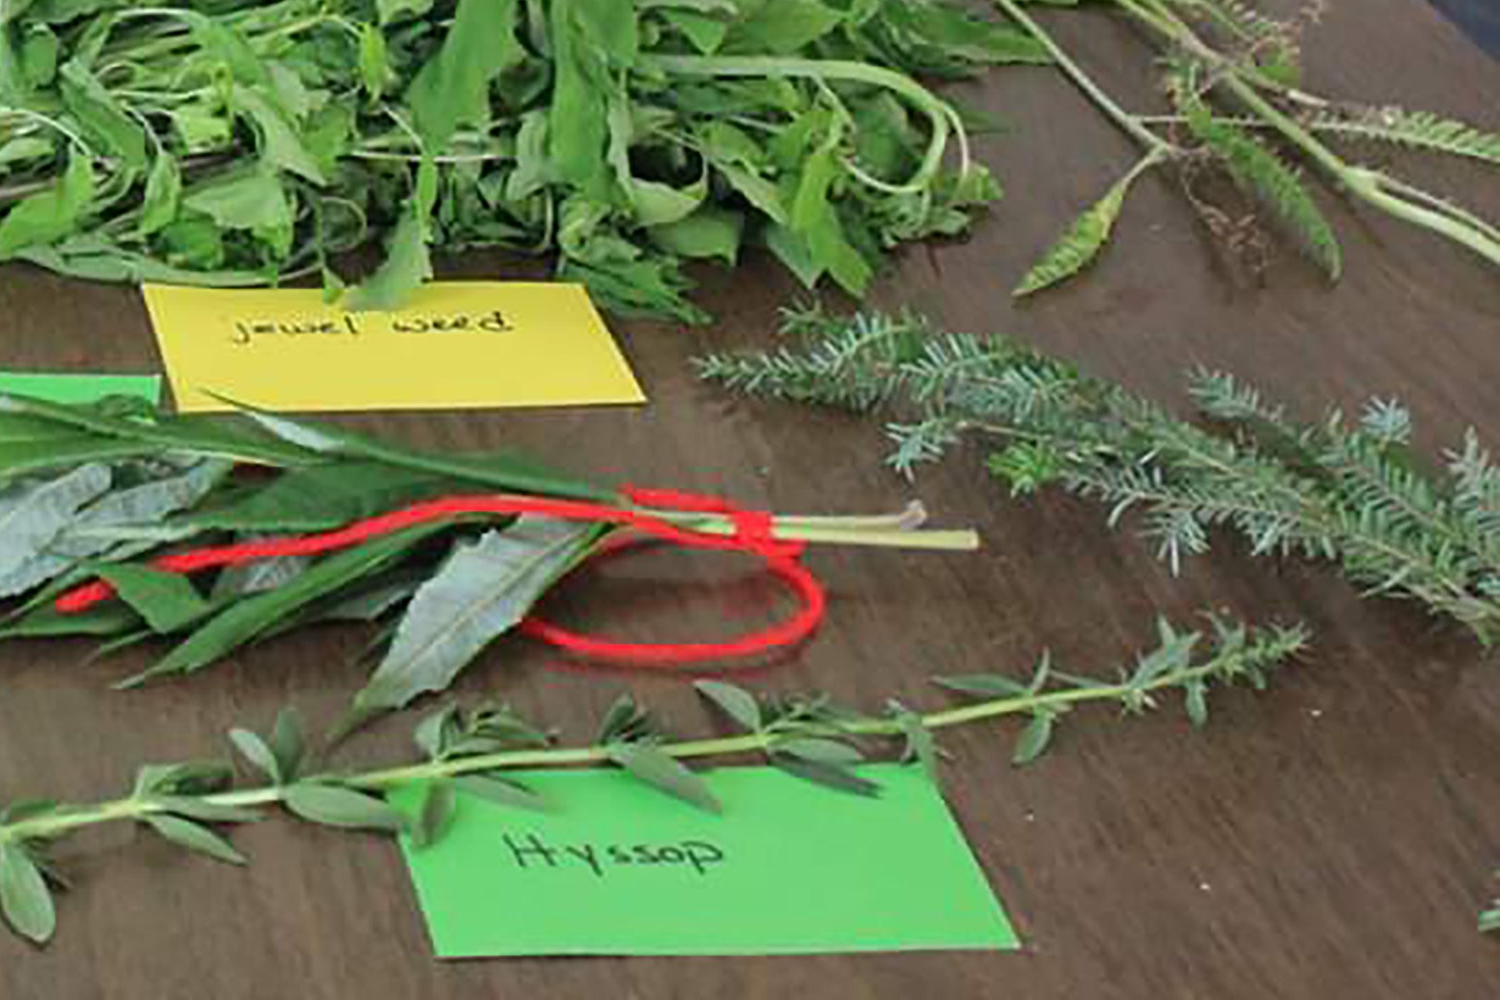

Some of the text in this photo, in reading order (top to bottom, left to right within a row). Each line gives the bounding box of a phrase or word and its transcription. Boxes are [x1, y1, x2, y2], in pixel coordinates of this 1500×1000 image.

[232, 310, 514, 344] jewel weed
[501, 833, 724, 877] Hyssop
